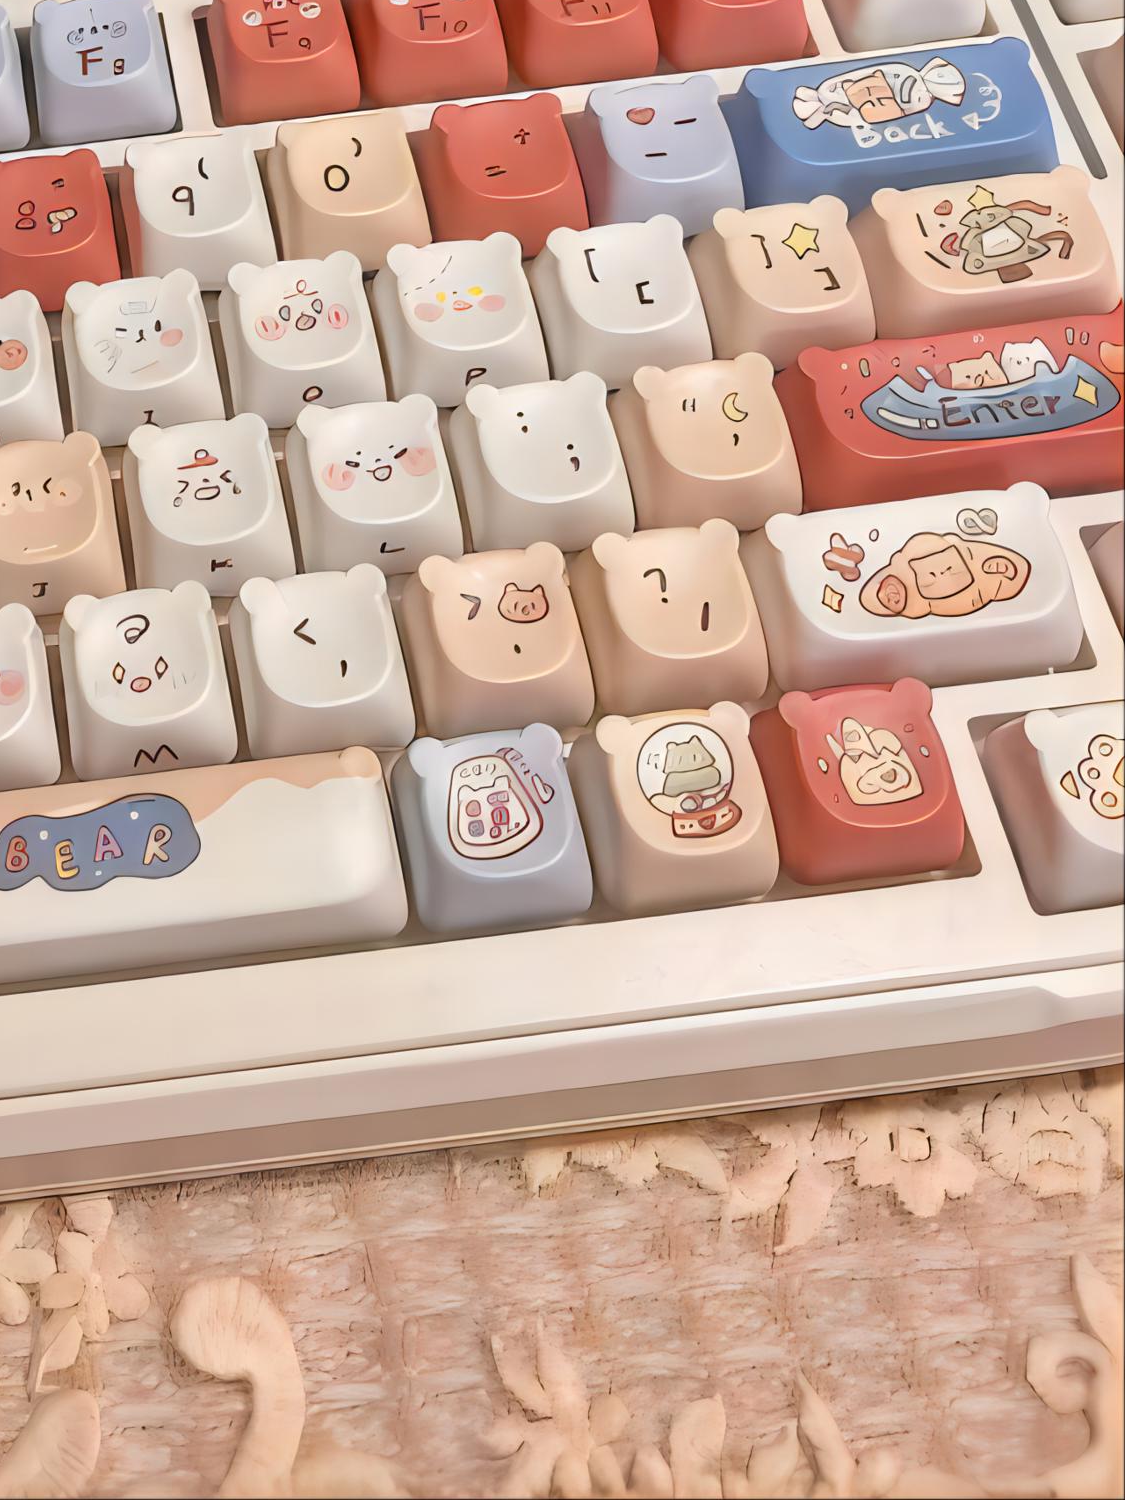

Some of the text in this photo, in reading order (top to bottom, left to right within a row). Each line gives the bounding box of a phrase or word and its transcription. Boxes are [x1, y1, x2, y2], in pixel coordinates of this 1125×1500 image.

[412, 1, 468, 35] F10
[264, 19, 313, 51] F9
[76, 46, 126, 77] F8
[850, 112, 957, 149] Back
[16, 200, 36, 230] 8
[171, 186, 195, 217] 9
[938, 395, 1062, 428] Enter
[133, 743, 180, 769] M
[4, 822, 173, 882] BEAR
